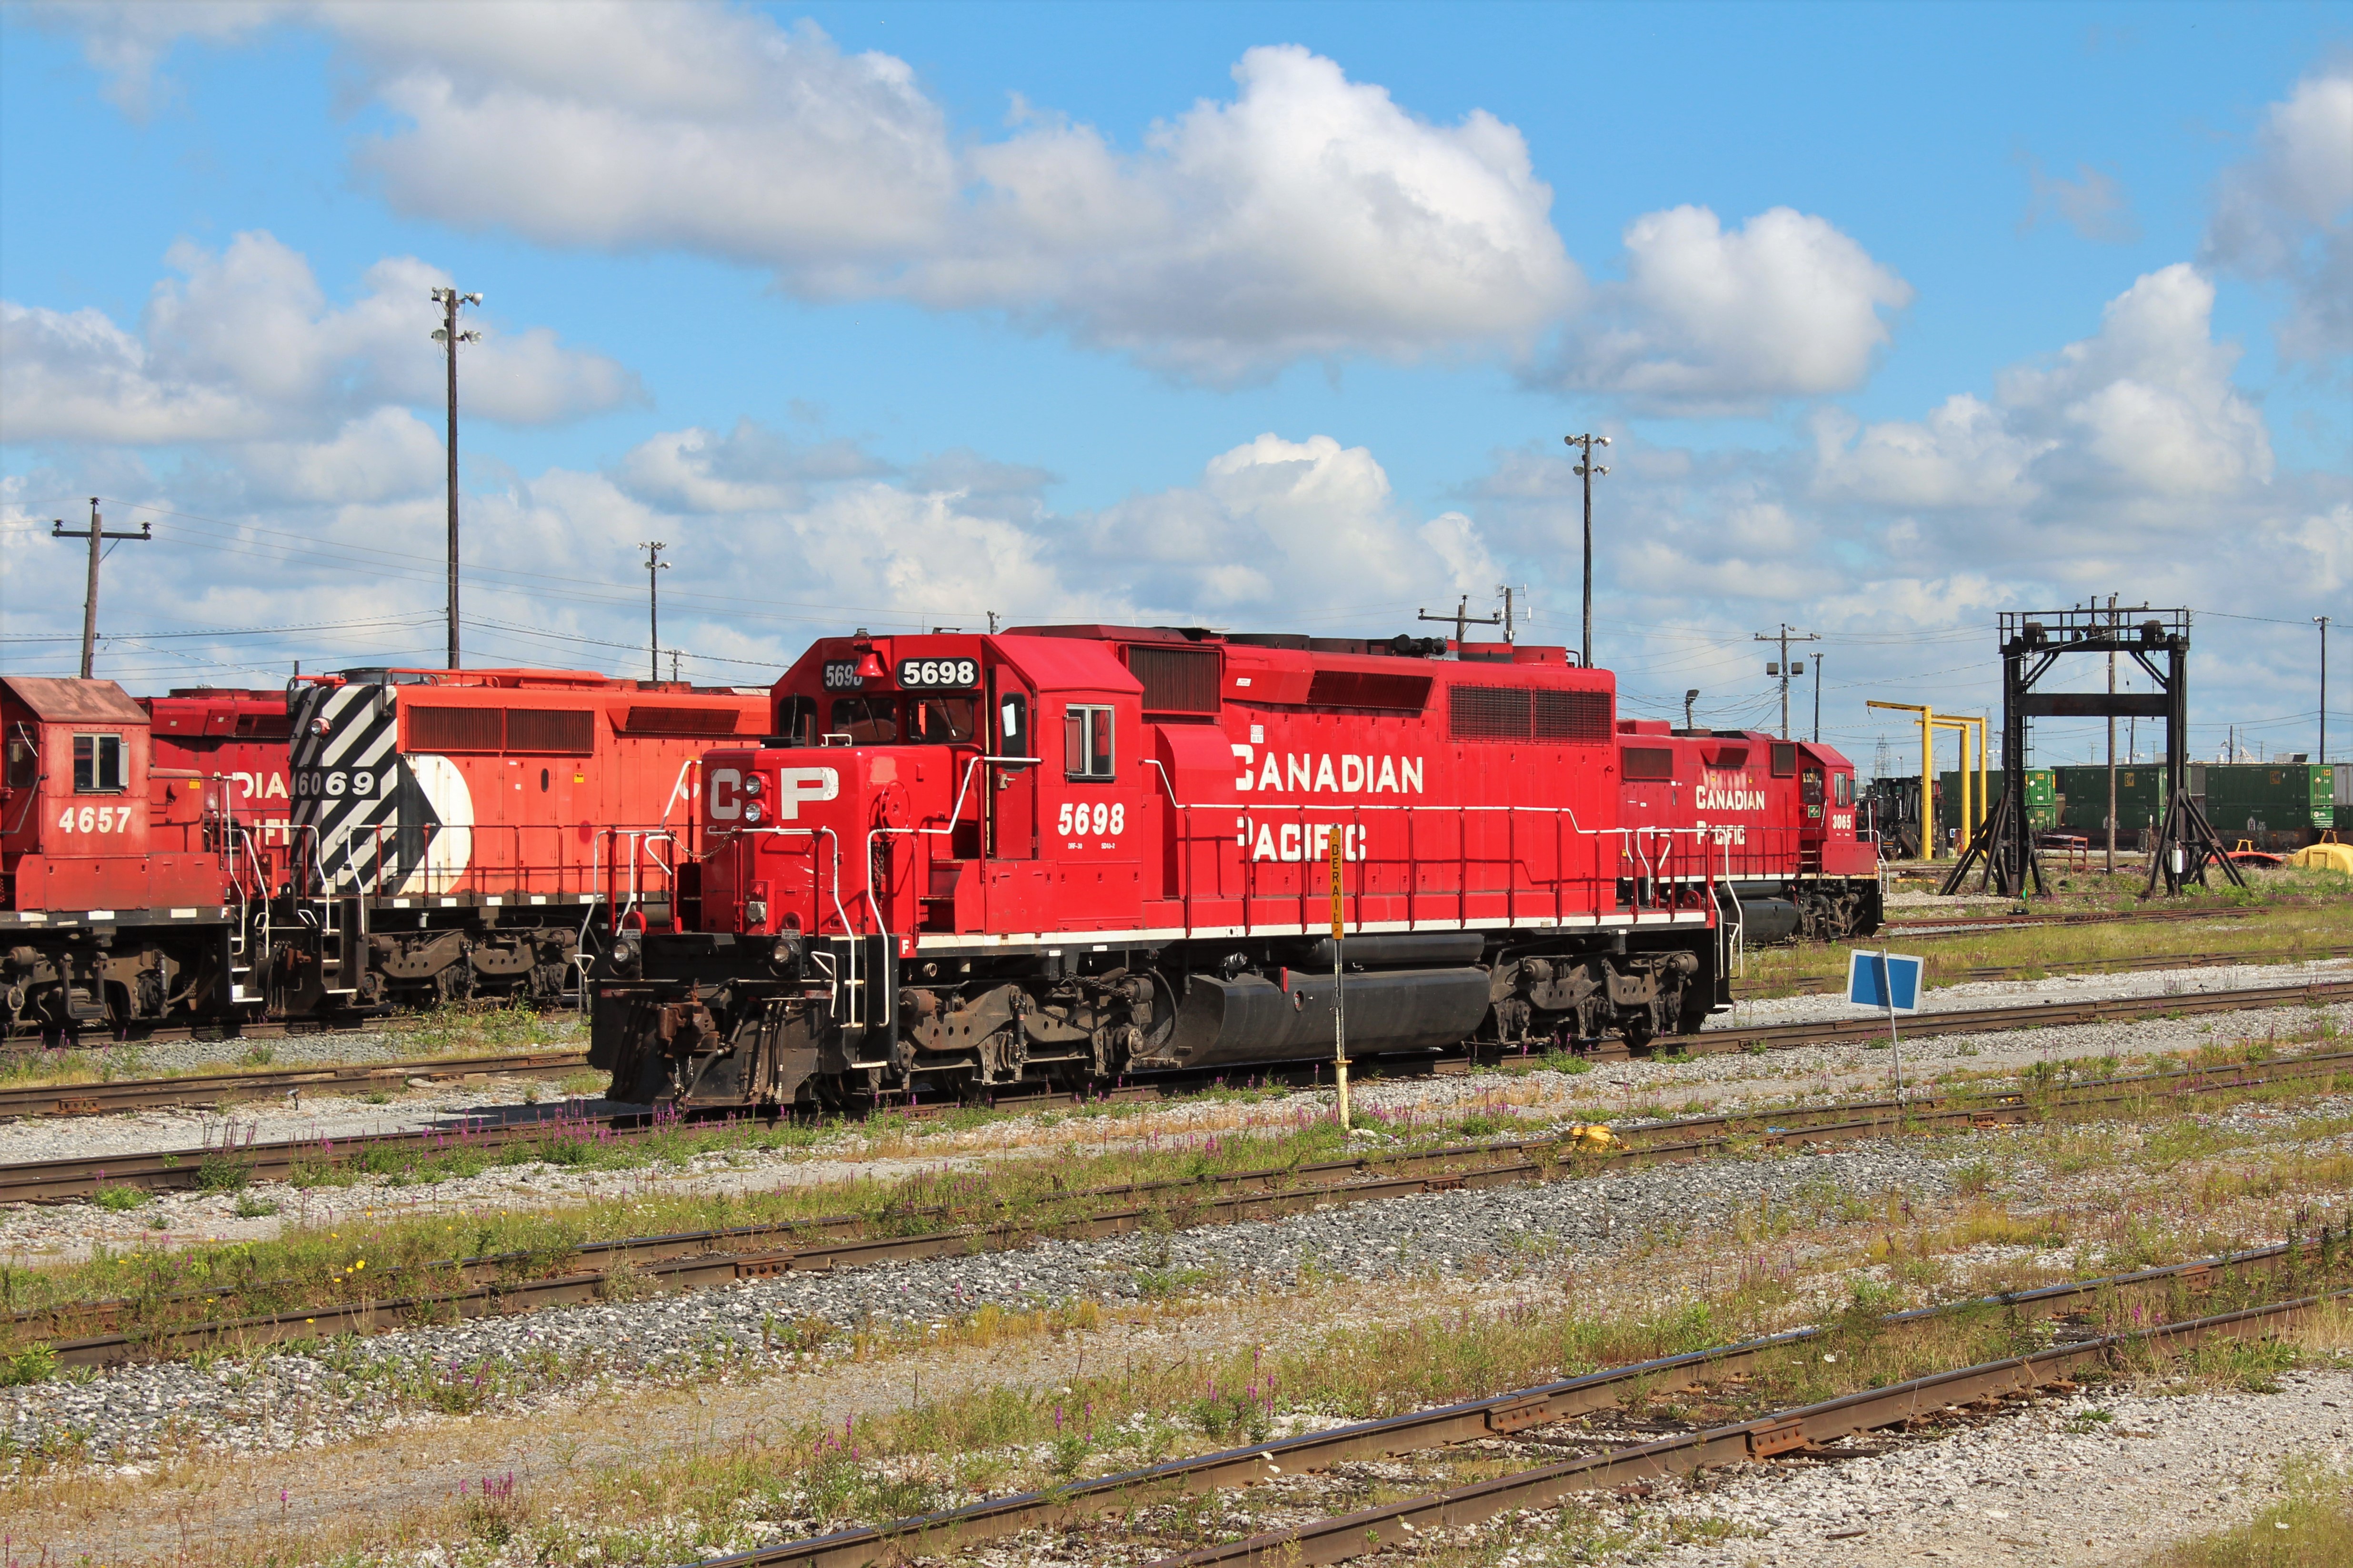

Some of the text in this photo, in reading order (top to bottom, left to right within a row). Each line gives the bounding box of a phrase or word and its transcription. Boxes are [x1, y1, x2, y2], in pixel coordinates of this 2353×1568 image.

[903, 661, 974, 684] 5698
[1231, 744, 1423, 794] CANADIAN
[298, 771, 374, 796] 6069
[1696, 785, 1765, 810] CANADIAN
[59, 807, 131, 833] 4657
[1058, 803, 1124, 836] 5698
[1832, 814, 1851, 829] 3065
[1237, 816, 1366, 862] PACIFC
[1696, 820, 1745, 845] PCIFIC
[902, 939, 910, 954] F
